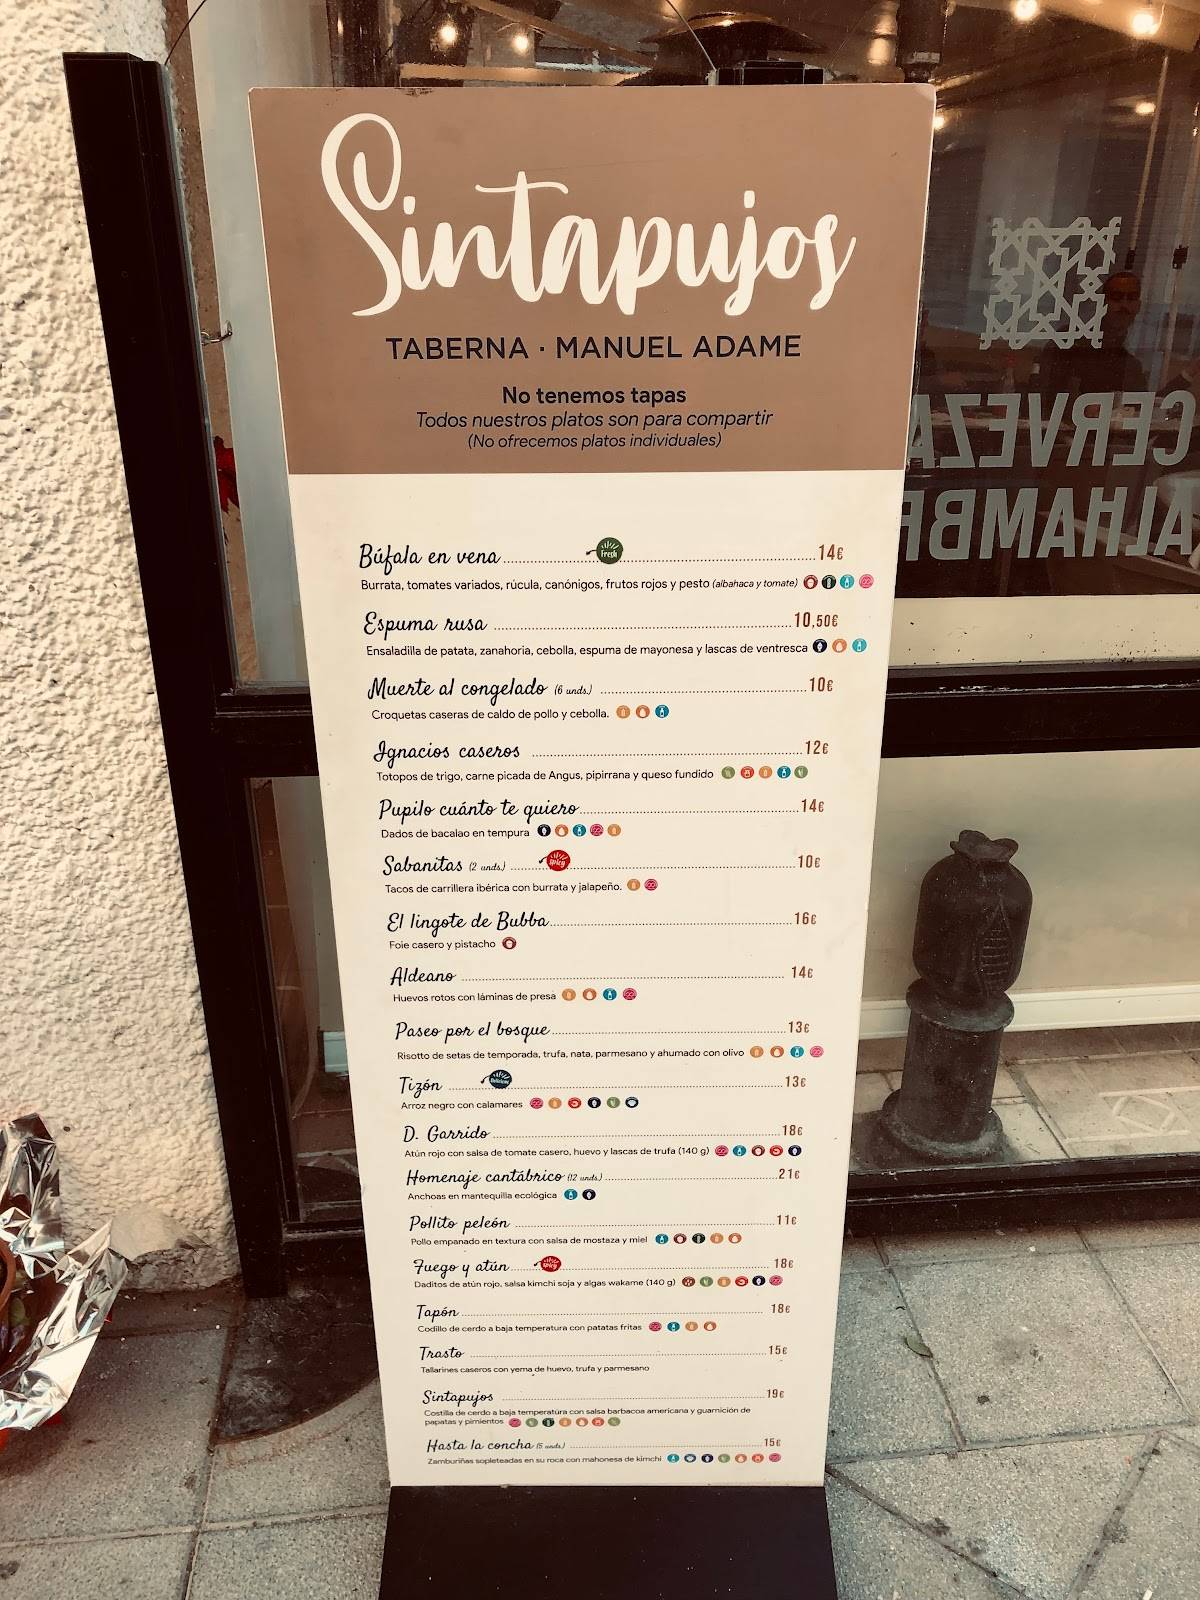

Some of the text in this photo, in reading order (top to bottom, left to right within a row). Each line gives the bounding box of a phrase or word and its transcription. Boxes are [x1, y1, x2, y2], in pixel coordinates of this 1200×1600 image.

[320, 112, 857, 317] Sintapujos
[385, 335, 800, 359] TABERNA MANUEL ADAME
[502, 386, 686, 408] No tenemos tapas
[416, 409, 773, 431] Todos nuestros platos son para compartir
[468, 431, 721, 451] (No ofrecemos platos individuales)
[358, 543, 843, 576] Búfala en vena 14€
[360, 577, 798, 592] Burrata, tomates variados, rúcula, canónigos, frutos rojos y pesto (albahaca y tomate)
[363, 611, 838, 641] Espuma rusa 10,50€
[367, 676, 833, 706] Muerte al congelado (6 unds.) 10€
[371, 708, 609, 721] Croquetas caseras de caldo de pollo y cebolla.
[372, 740, 828, 769] Ignacios caseros 12€
[378, 798, 824, 825] Pupilo cuánto te quiero 14€
[381, 829, 413, 838] Dados
[415, 829, 428, 838] de
[430, 828, 470, 837] bacalao
[487, 829, 530, 839] tempura
[382, 854, 820, 875] Sabanitas (2 unds.) 10€
[384, 884, 414, 893] Tacos
[416, 884, 428, 893] de
[431, 883, 474, 892] carrillera
[476, 883, 510, 892] ibérica
[532, 882, 568, 891] burrata
[570, 884, 576, 893] y
[578, 882, 622, 893] jalapeño.
[386, 910, 816, 938] El lingote de Bubba 16€
[389, 940, 409, 949] Foie
[446, 942, 452, 950] y
[454, 939, 496, 950] pistacho
[390, 965, 813, 986] Aldeano 14€
[393, 993, 428, 1002] Huevos
[477, 992, 513, 1000] láminas
[515, 992, 528, 1000] de
[530, 993, 556, 1002] presa
[394, 1020, 809, 1044] Paseo por el bosque 13€
[399, 1075, 806, 1098] Tizón 13€
[400, 1101, 426, 1109] Arroz
[428, 1103, 455, 1111] negro
[476, 1100, 522, 1108] calamares
[403, 1124, 802, 1142] D. Garrido 18€
[406, 1169, 481, 1190] Homenaje
[485, 1168, 565, 1182] cantábrico
[579, 1173, 602, 1181] unds.)
[778, 1168, 800, 1179] 21€
[407, 1192, 446, 1200] Anchoas
[461, 1191, 512, 1200] mantequilla
[514, 1191, 557, 1200] ecológica
[409, 1214, 796, 1235] Pollito peleón 11€
[412, 1258, 793, 1279] Fuego y atún 18€
[416, 1303, 790, 1323] Tapón 18€
[495, 1325, 513, 1333] baja
[586, 1324, 618, 1332] patatas
[419, 1345, 787, 1360] Trasto 15€
[422, 1388, 784, 1408] Sintapujos 19€
[424, 1418, 456, 1426] papatas
[426, 1439, 467, 1452] Hasta
[470, 1439, 484, 1449] la
[487, 1438, 534, 1449] concha
[764, 1437, 781, 1446] 15€
